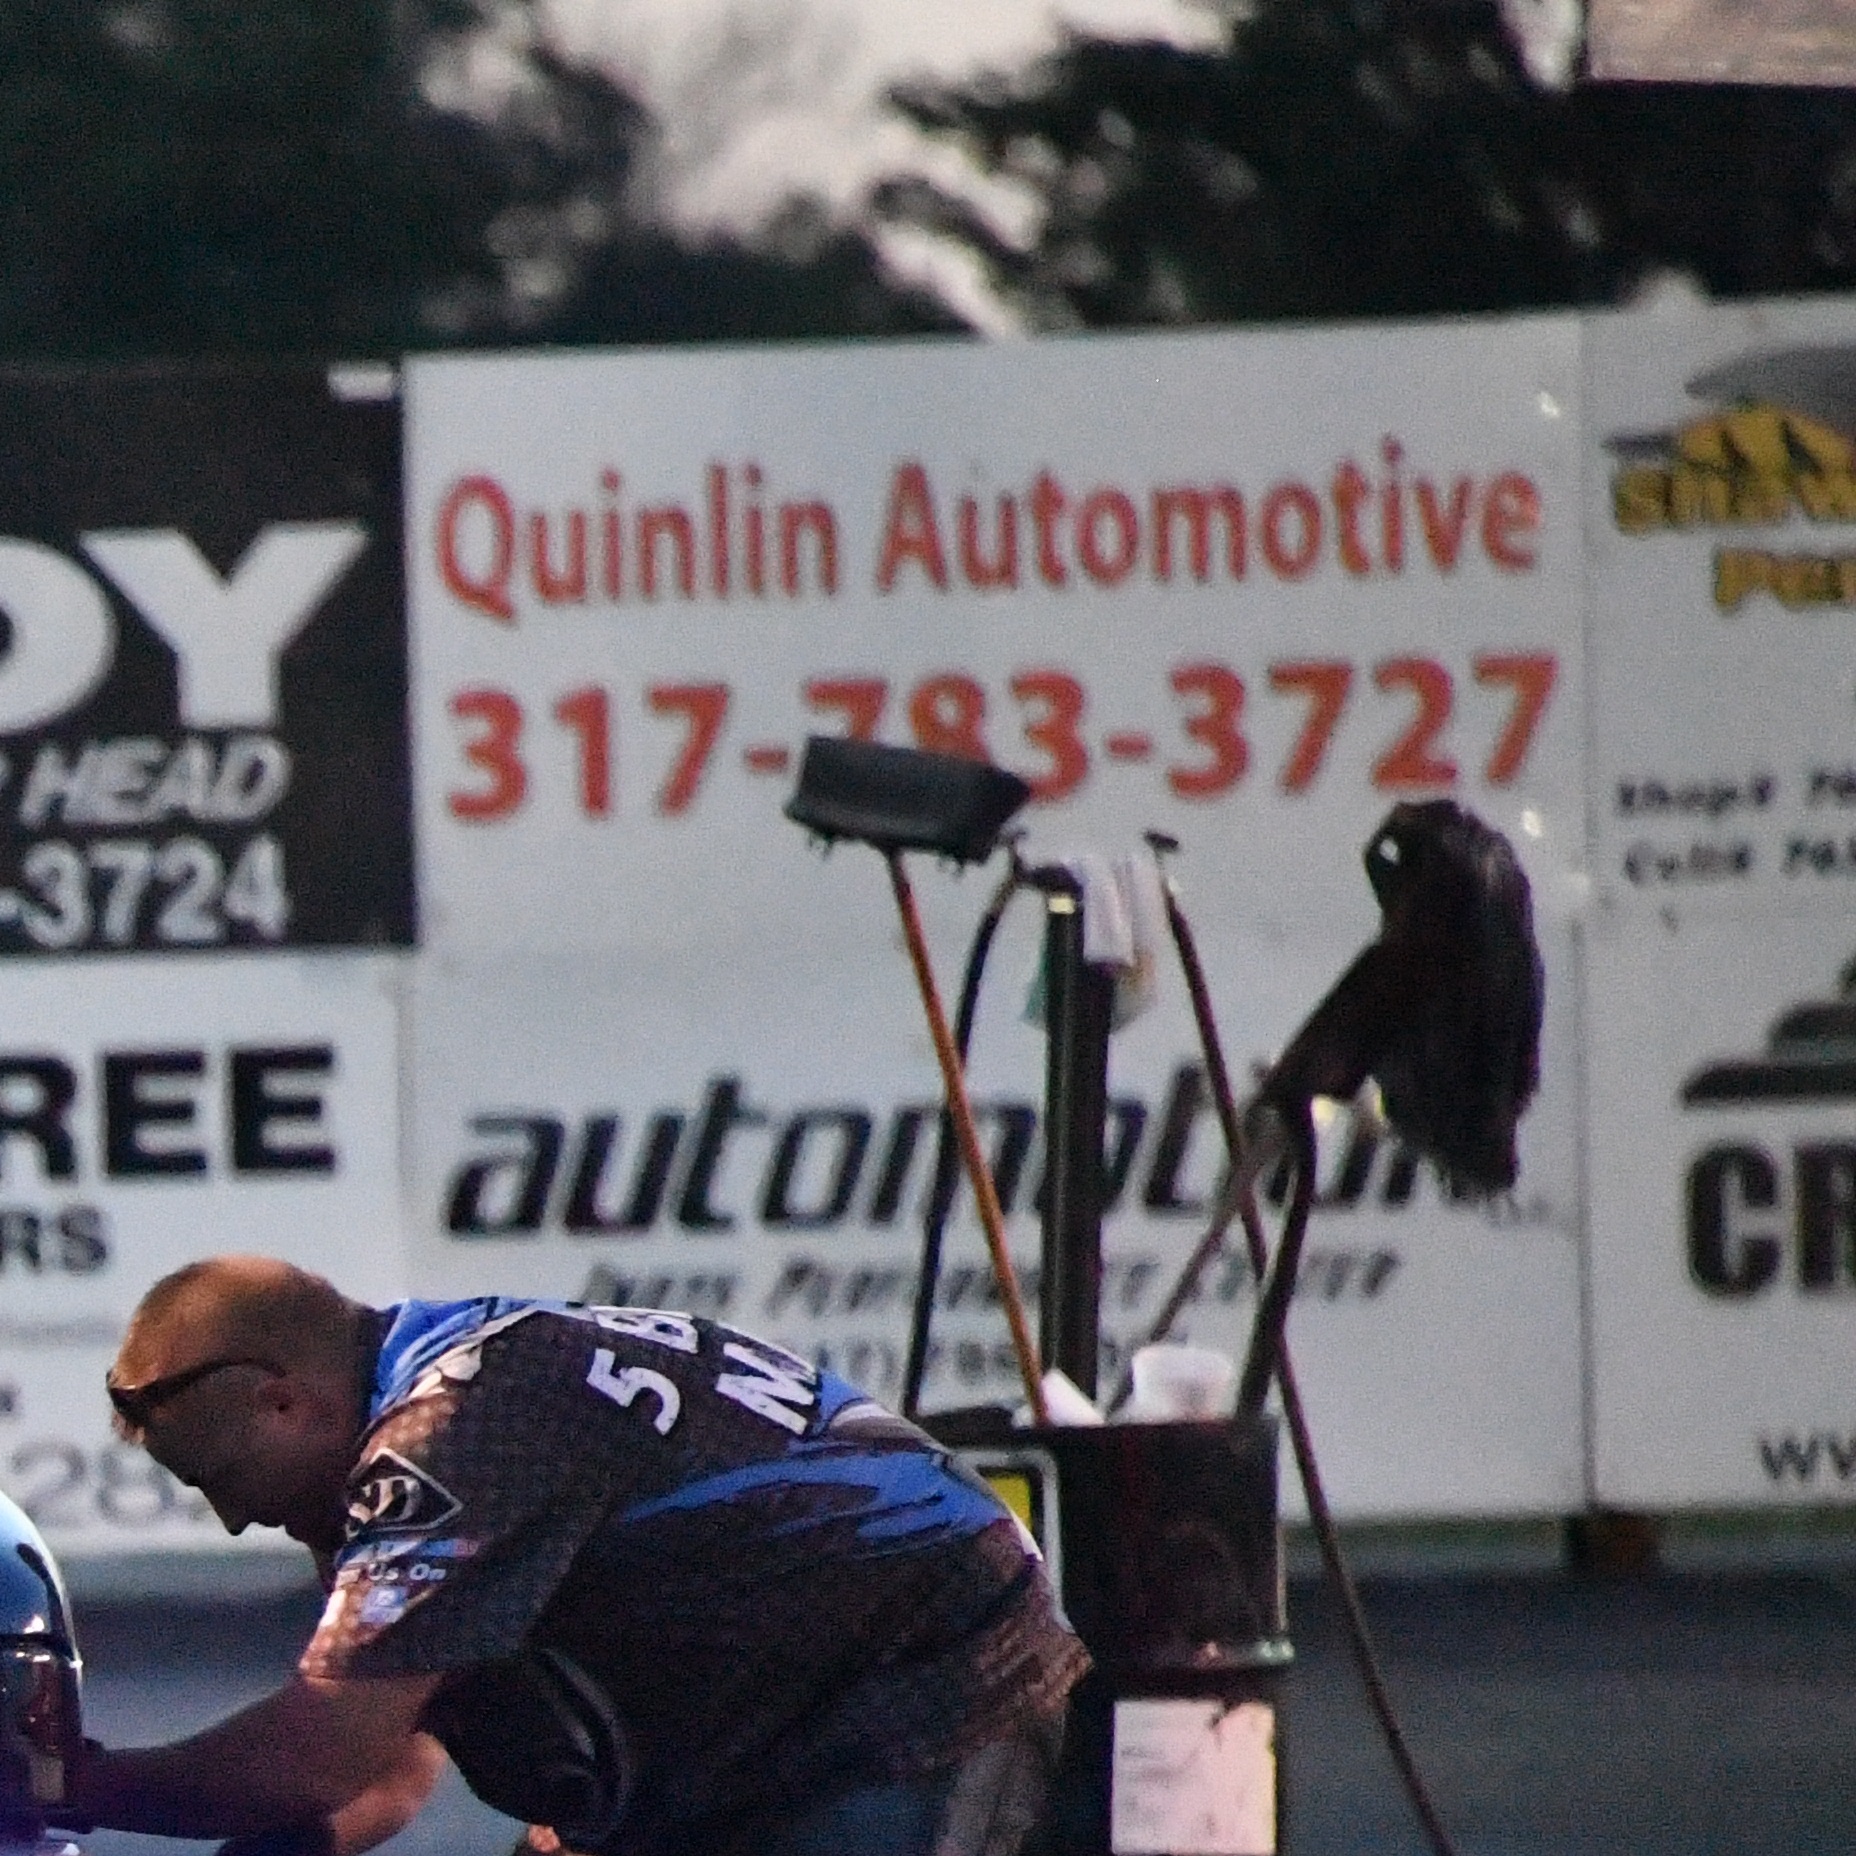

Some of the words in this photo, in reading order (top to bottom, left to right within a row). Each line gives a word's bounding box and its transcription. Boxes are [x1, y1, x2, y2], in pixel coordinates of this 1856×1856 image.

[435, 461, 841, 627] Quinlin
[876, 434, 1543, 595] Automotive
[20, 731, 287, 827] HEAD
[446, 650, 1558, 825] 317-783-3727
